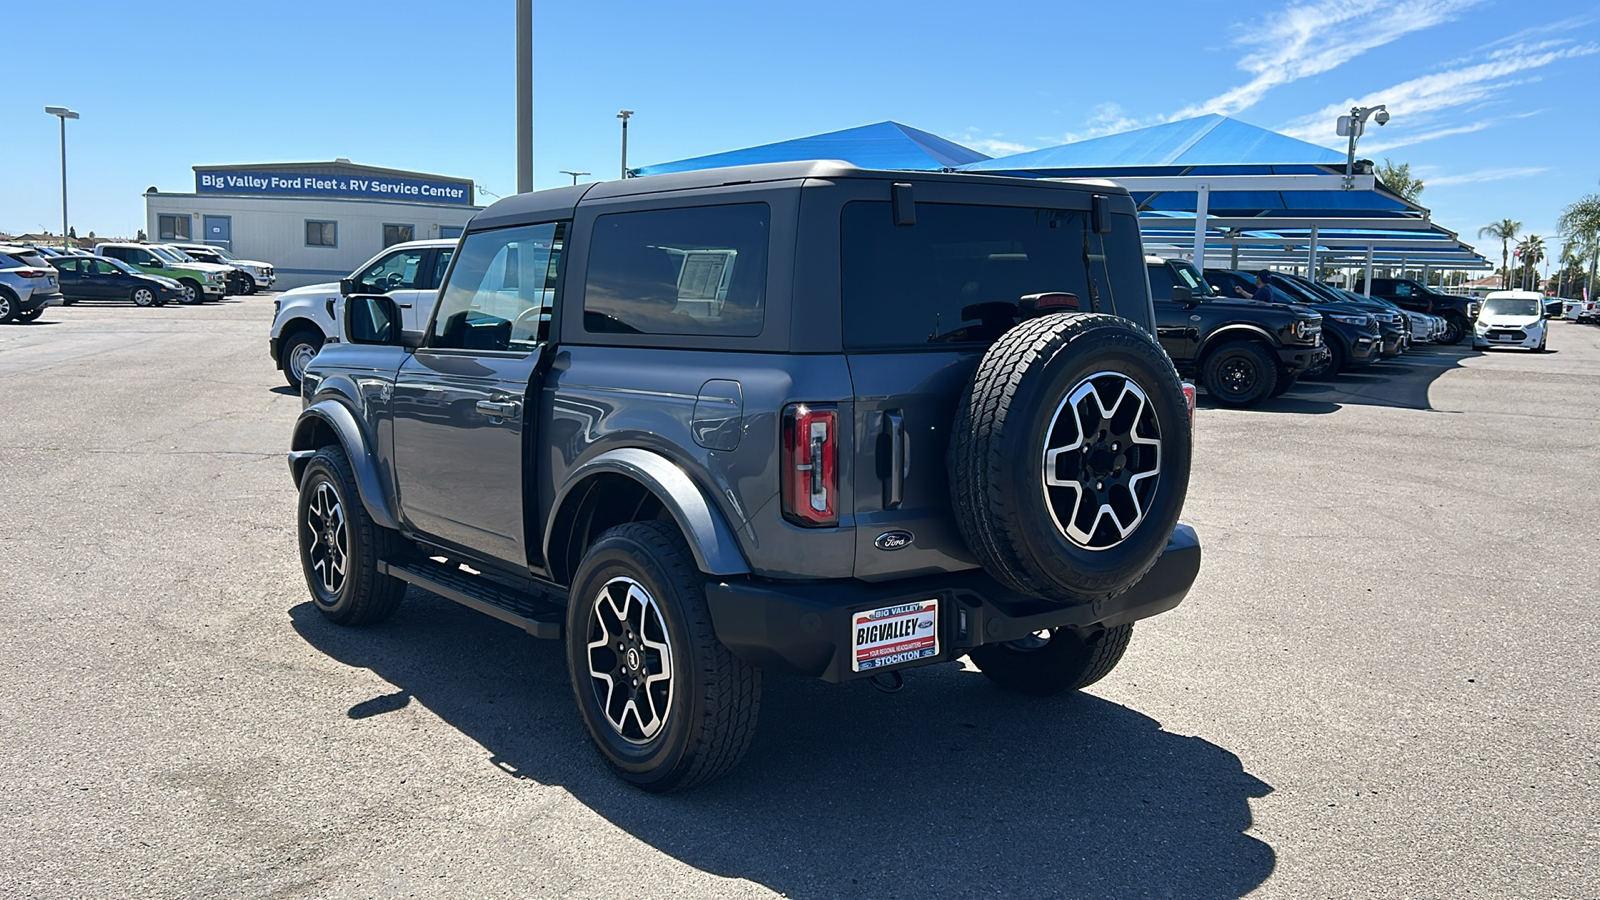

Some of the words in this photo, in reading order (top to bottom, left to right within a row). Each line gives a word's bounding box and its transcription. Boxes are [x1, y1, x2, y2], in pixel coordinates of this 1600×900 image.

[202, 175, 225, 188] Big
[227, 176, 268, 189] Valley
[271, 177, 301, 189] Ford
[304, 178, 338, 190] Fleet
[339, 182, 347, 190] &
[350, 180, 368, 191] RV
[371, 181, 419, 195] Service
[421, 184, 464, 198] Center
[875, 609, 889, 618] BIG
[891, 604, 920, 615] VALLEY
[857, 617, 919, 646] BIGVALLEY
[869, 649, 879, 658] YOUR
[875, 650, 920, 667] STOCKTON
